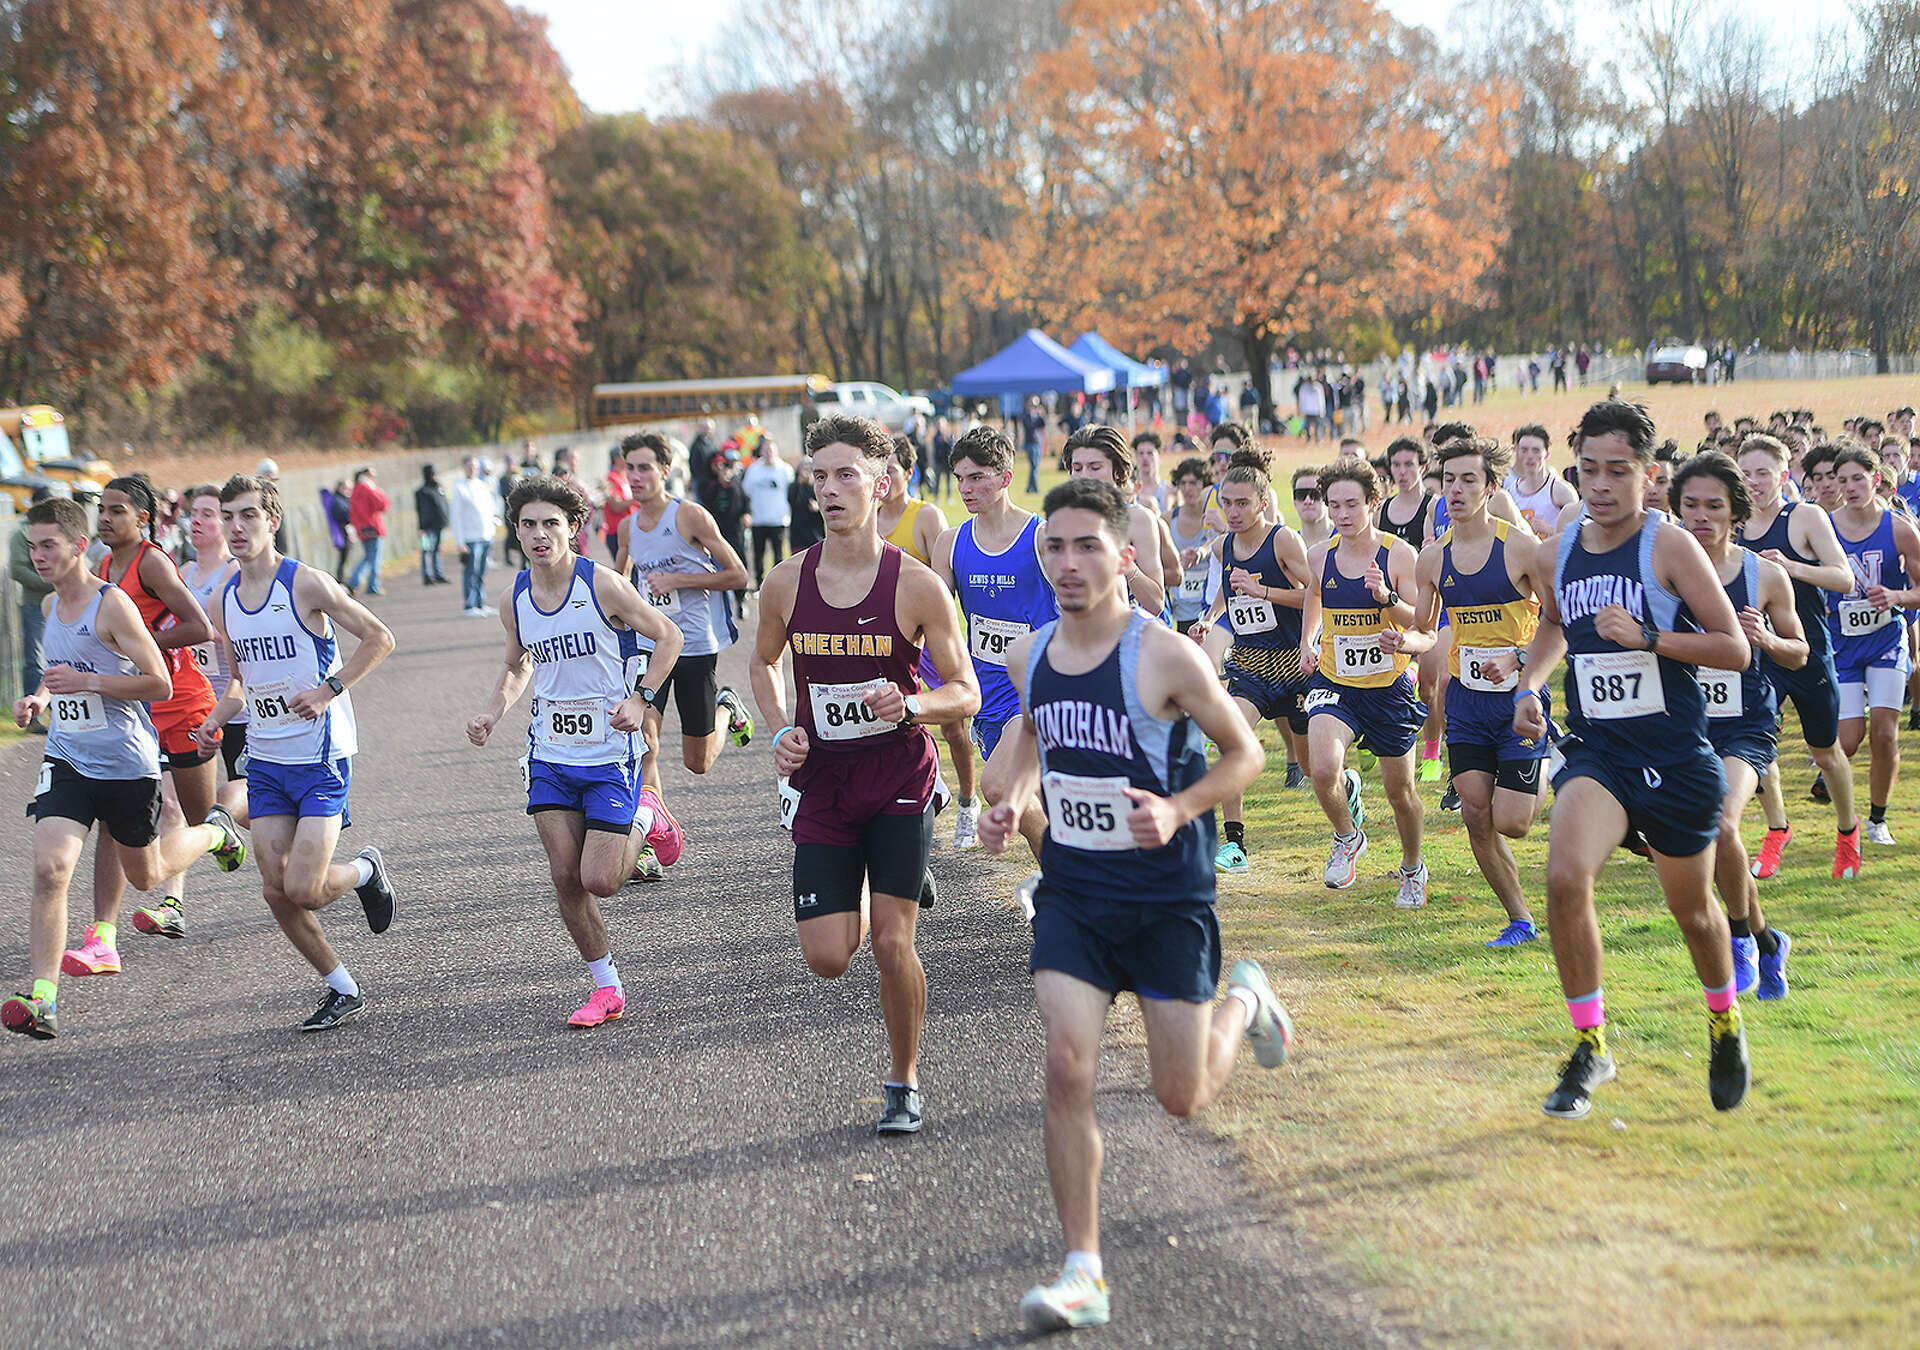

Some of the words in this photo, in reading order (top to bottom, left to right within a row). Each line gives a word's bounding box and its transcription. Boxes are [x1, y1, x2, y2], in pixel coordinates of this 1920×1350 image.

[969, 574, 989, 584] LEWIS
[990, 574, 995, 584] S
[996, 574, 1016, 585] MILLS
[1234, 606, 1266, 625] 815
[1332, 613, 1381, 627] WESTON
[1849, 610, 1880, 627] 807
[792, 632, 892, 657] SHEEHAN
[1344, 646, 1383, 667] 878
[1592, 672, 1642, 702] 887
[58, 699, 91, 721] 831
[255, 695, 290, 719] 861
[825, 700, 878, 727] 840
[552, 712, 593, 736] 859
[1061, 798, 1115, 832] 885
